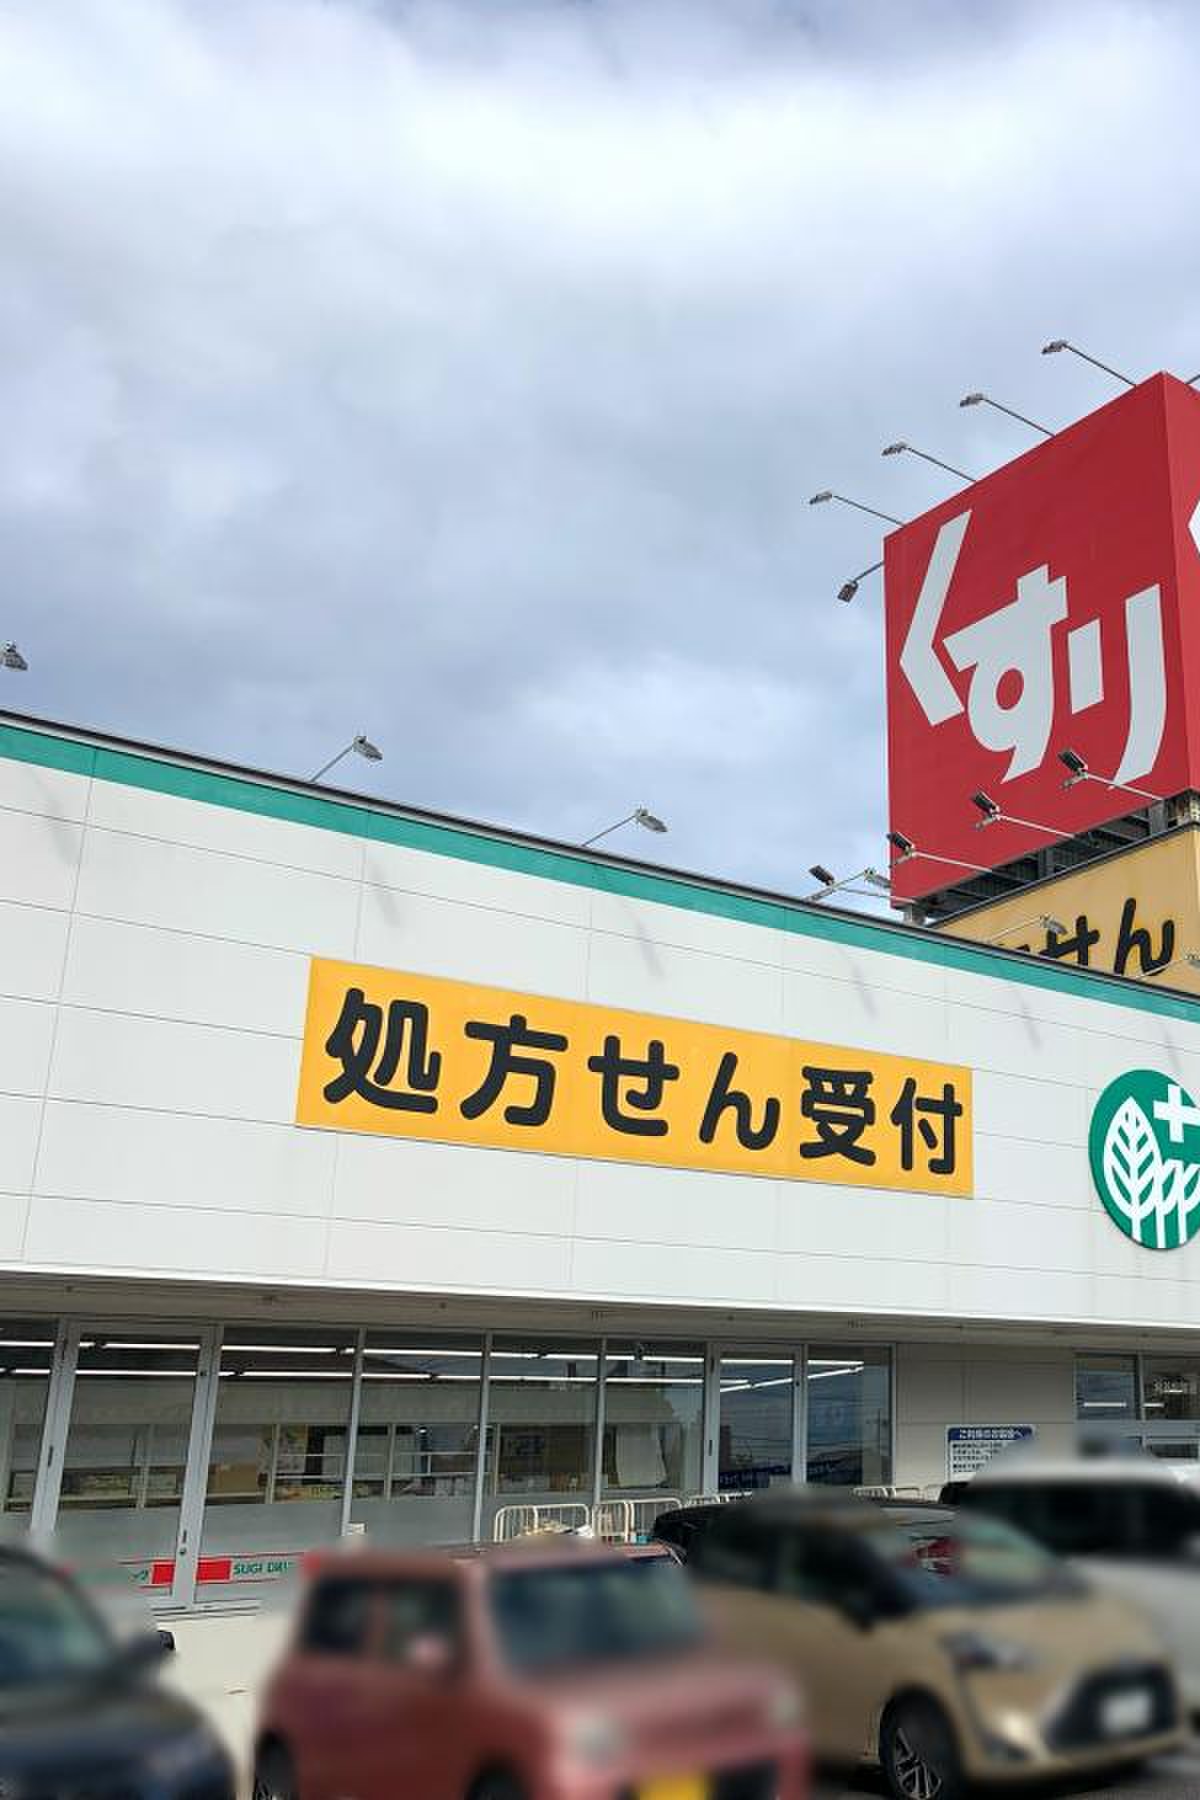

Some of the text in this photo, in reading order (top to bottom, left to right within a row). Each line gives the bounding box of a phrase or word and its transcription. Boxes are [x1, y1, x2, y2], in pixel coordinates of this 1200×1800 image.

[900, 509, 1167, 788] くすり
[323, 987, 963, 1175] 処方せん受付
[233, 1560, 263, 1575] SUGI
